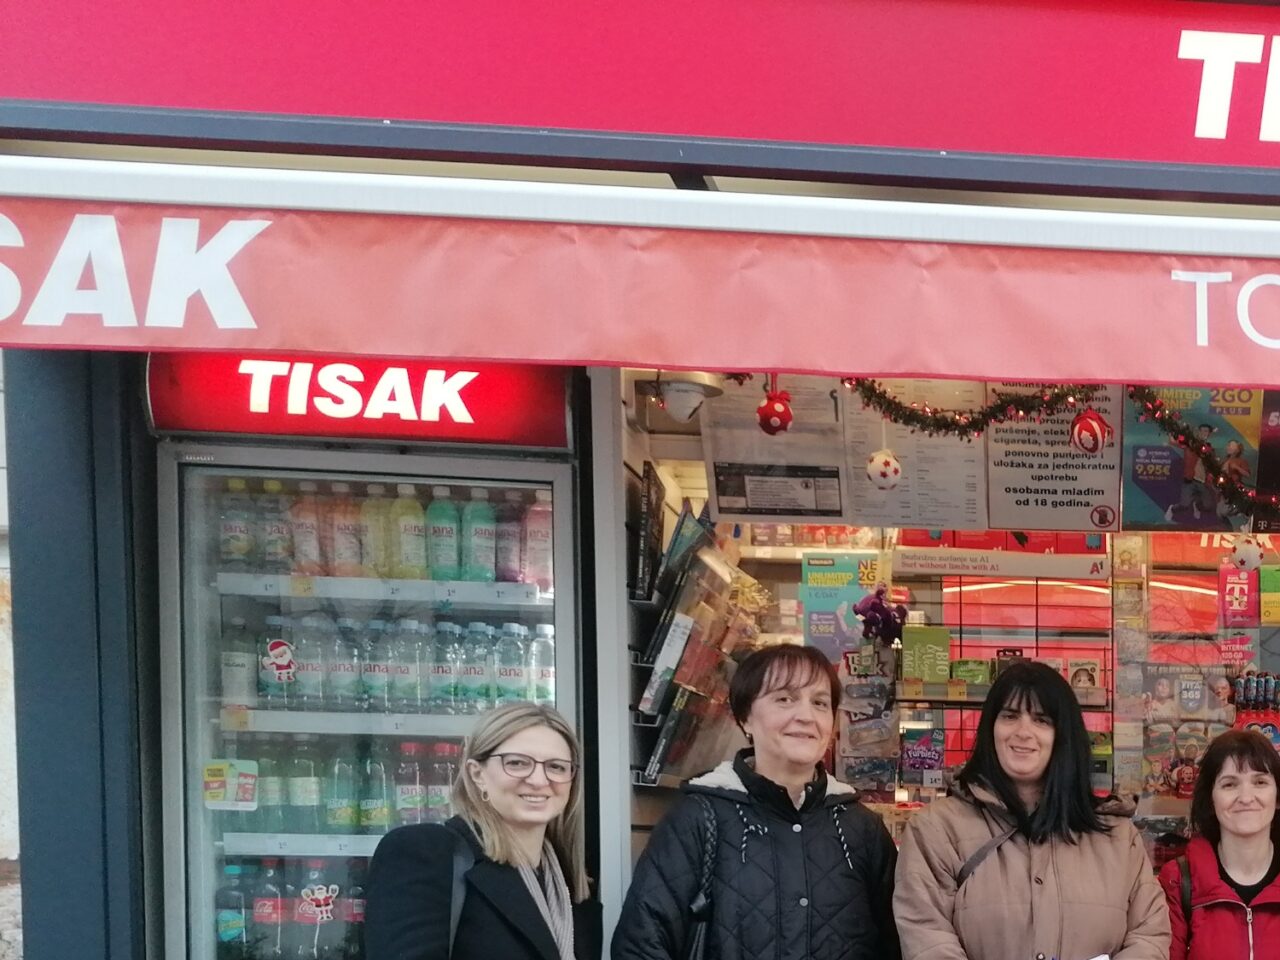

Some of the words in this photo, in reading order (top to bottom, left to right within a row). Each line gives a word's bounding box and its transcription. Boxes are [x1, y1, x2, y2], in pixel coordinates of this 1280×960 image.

[0, 213, 272, 329] AK
[239, 360, 478, 422] TISAK
[1210, 388, 1253, 404] 2GO
[1216, 407, 1243, 415] PLUS
[1005, 449, 1049, 459] ponovno
[993, 460, 1034, 469] uložaka
[1052, 461, 1115, 471] jednokratnu
[1031, 473, 1078, 483] upotrebu
[1004, 485, 1058, 495] osobama
[1015, 498, 1029, 507] od
[1035, 498, 1047, 507] 18
[1051, 498, 1093, 508] godina.
[858, 559, 877, 571] NE
[919, 562, 947, 570] without
[1089, 561, 1103, 575] A1
[858, 570, 877, 582] 2G
